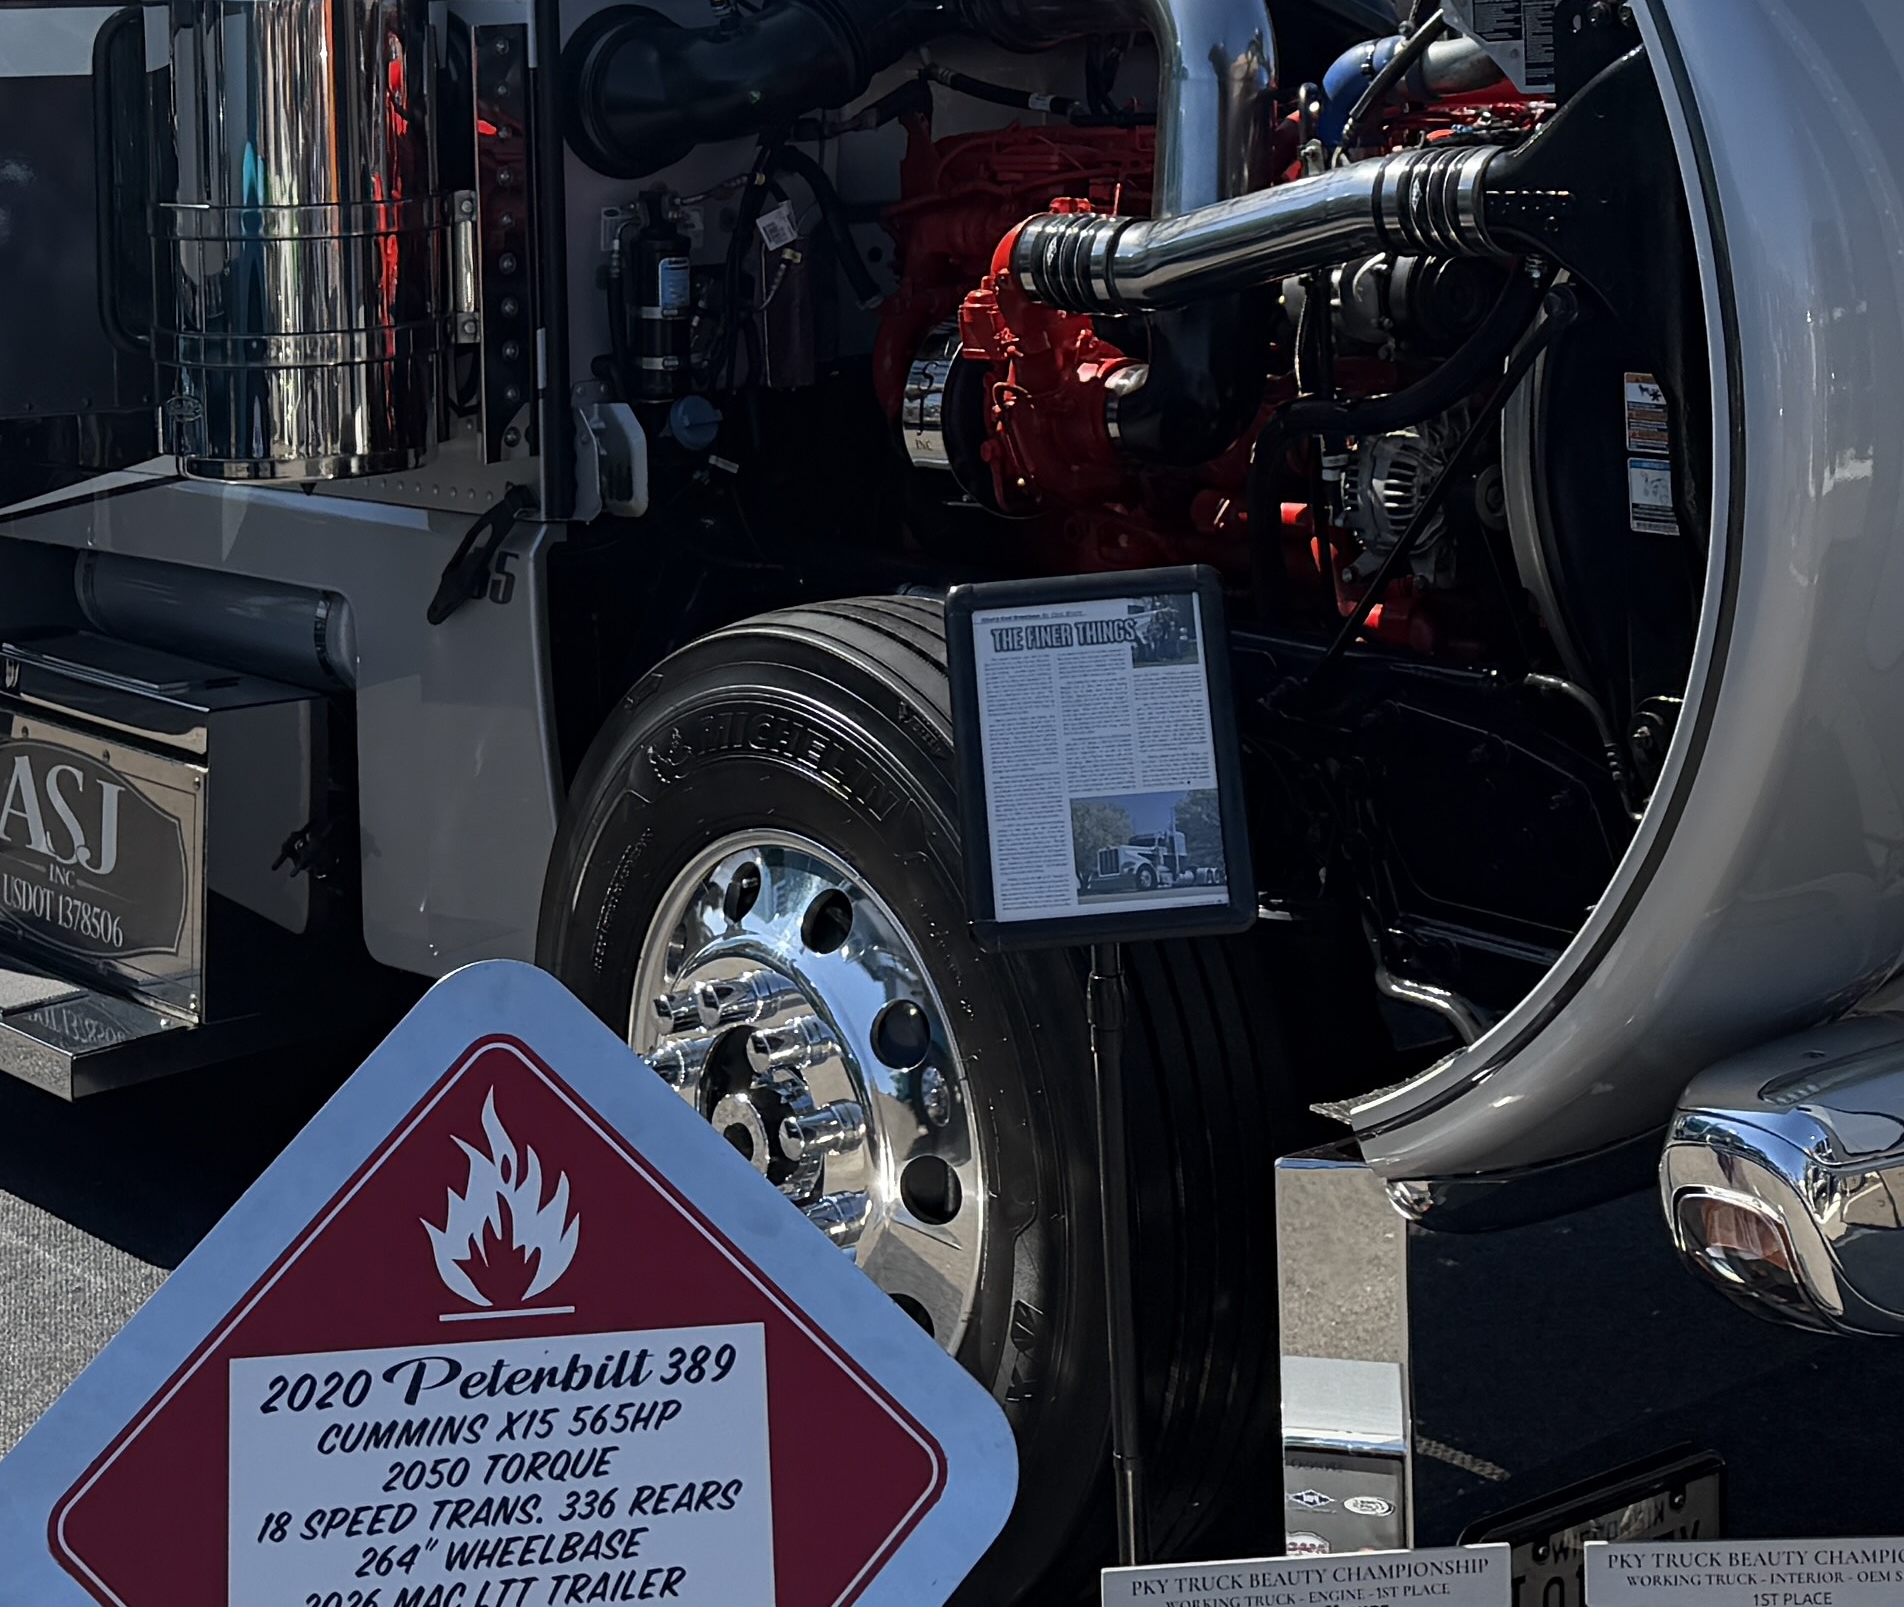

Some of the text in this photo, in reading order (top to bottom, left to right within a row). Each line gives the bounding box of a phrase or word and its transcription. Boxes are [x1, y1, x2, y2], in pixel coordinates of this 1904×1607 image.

[991, 618, 1137, 653] THE FINER THINGS
[698, 711, 900, 821] MICHELIN
[49, 863, 75, 888] INC
[3, 873, 123, 948] USDOT 1378506
[260, 1343, 736, 1414] 2020 Peterbilt 389
[317, 1399, 682, 1455] CUMMINS X15 565HP
[382, 1446, 619, 1493] 2050 TORQUE
[257, 1479, 743, 1543] 18 SPEED TRANS. 336 REARS
[355, 1527, 649, 1578] 264" WHEELBASE
[1608, 1553, 1647, 1569] PKY
[1651, 1551, 1722, 1569] TRUCK
[1728, 1549, 1808, 1567] BEAUTY
[394, 1581, 467, 1607] MAC
[475, 1576, 539, 1607] LTT
[548, 1566, 686, 1606] TRAILER
[1132, 1558, 1489, 1596] PKY TRUCK BEAUTY CHAMPIONSHIP
[1165, 1596, 1241, 1607] WORKING
[1244, 1593, 1296, 1607] TRUCK
[1309, 1588, 1365, 1604] ENGINE
[1403, 1582, 1450, 1597] PLACE
[1626, 1573, 1701, 1587] WORKING
[1704, 1573, 1757, 1585] TRUCK
[1770, 1571, 1845, 1585] INTERIOR
[1857, 1570, 1891, 1583] OEM
[1754, 1591, 1832, 1607] 1ST PLACE
